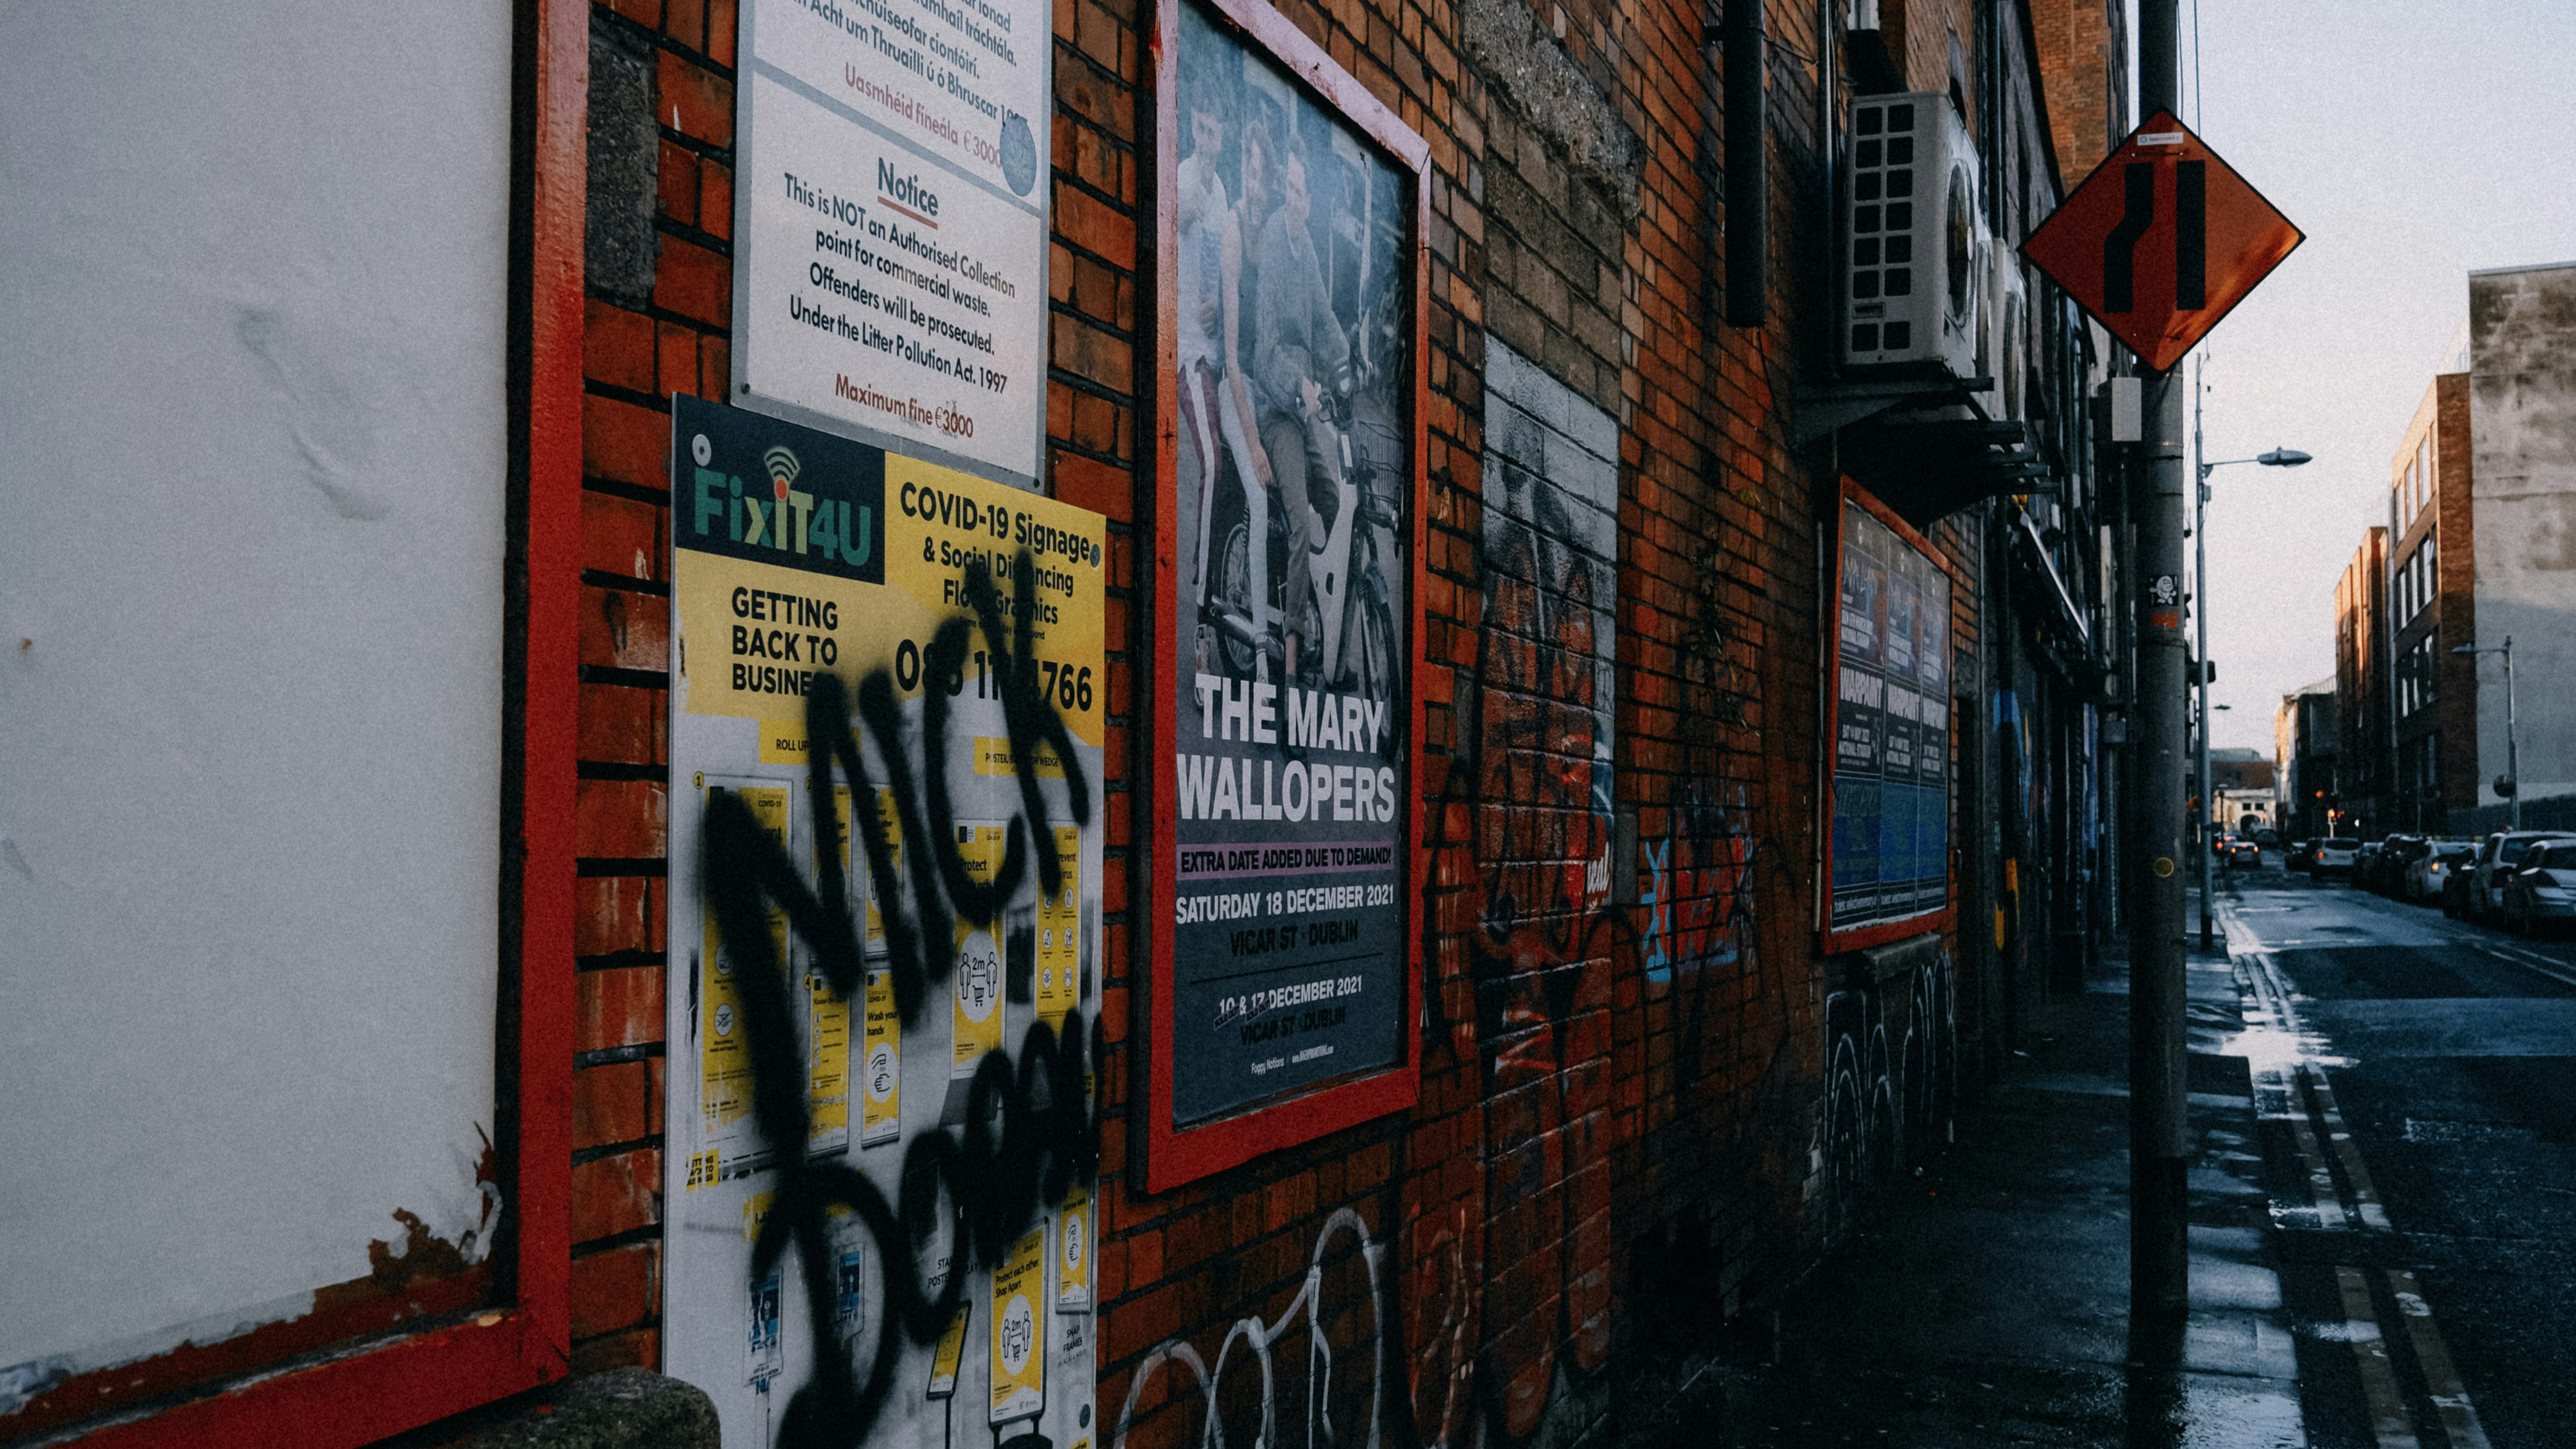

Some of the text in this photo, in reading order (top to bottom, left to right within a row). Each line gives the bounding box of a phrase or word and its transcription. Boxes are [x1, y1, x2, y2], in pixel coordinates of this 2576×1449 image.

[810, 0, 843, 28] Acht
[846, 17, 868, 44] um
[948, 71, 998, 120] Bhruscar
[965, 17, 1017, 67] tráchtála.
[845, 62, 913, 121] Uasmhéid
[878, 156, 938, 217] Notice
[784, 172, 1015, 298] This is NOT an Authorised Collection
[816, 229, 991, 318] point for commercial waste.
[810, 262, 995, 355] Offenders will be prosecuted.
[790, 294, 1008, 394] Under the Litter Pollution Act. 1997
[835, 373, 974, 438] Maximum fine €3000
[900, 481, 1090, 564] COVID-19 Signage
[923, 536, 935, 563] &
[996, 553, 1074, 597] Dincing
[732, 586, 838, 630] GETTING
[733, 625, 838, 666] BACK TO
[733, 663, 823, 697] BUSINE
[1195, 673, 1384, 754] THE MARY
[776, 738, 796, 752] ROLL
[1040, 756, 1059, 767] WEDGE
[1177, 753, 1395, 823] WALLOPERS
[960, 858, 987, 872] Protect
[1058, 852, 1076, 862] revent
[1061, 869, 1072, 879] irus
[1181, 846, 1391, 873] EXTRA DATE ADDED DUE TO DEMAND!
[1175, 884, 1393, 924] SATURDAY 18 DECEMBER 2021
[1230, 919, 1358, 957] VICAR ST DUBLIN
[972, 957, 985, 970] 2m
[1239, 995, 1246, 1015] &
[1269, 980, 1334, 1009] DECEMBER
[1337, 975, 1362, 996] 2021
[867, 1011, 884, 1022] Wash
[867, 1025, 884, 1036] hands
[1215, 1013, 1228, 1029] SOLD
[1240, 1005, 1346, 1046] VICAR ST DUBLIN
[1246, 1008, 1259, 1022] SOLD
[1251, 1062, 1266, 1076] Foggy
[1266, 1056, 1284, 1070] Notions
[928, 1272, 949, 1288] POSTE
[995, 1259, 1039, 1285] Protect each other
[995, 1280, 1022, 1298] Shop Apart
[1011, 1320, 1021, 1331] 2m
[1067, 1325, 1080, 1338] SNAP
[1063, 1337, 1083, 1354] FRAMES
